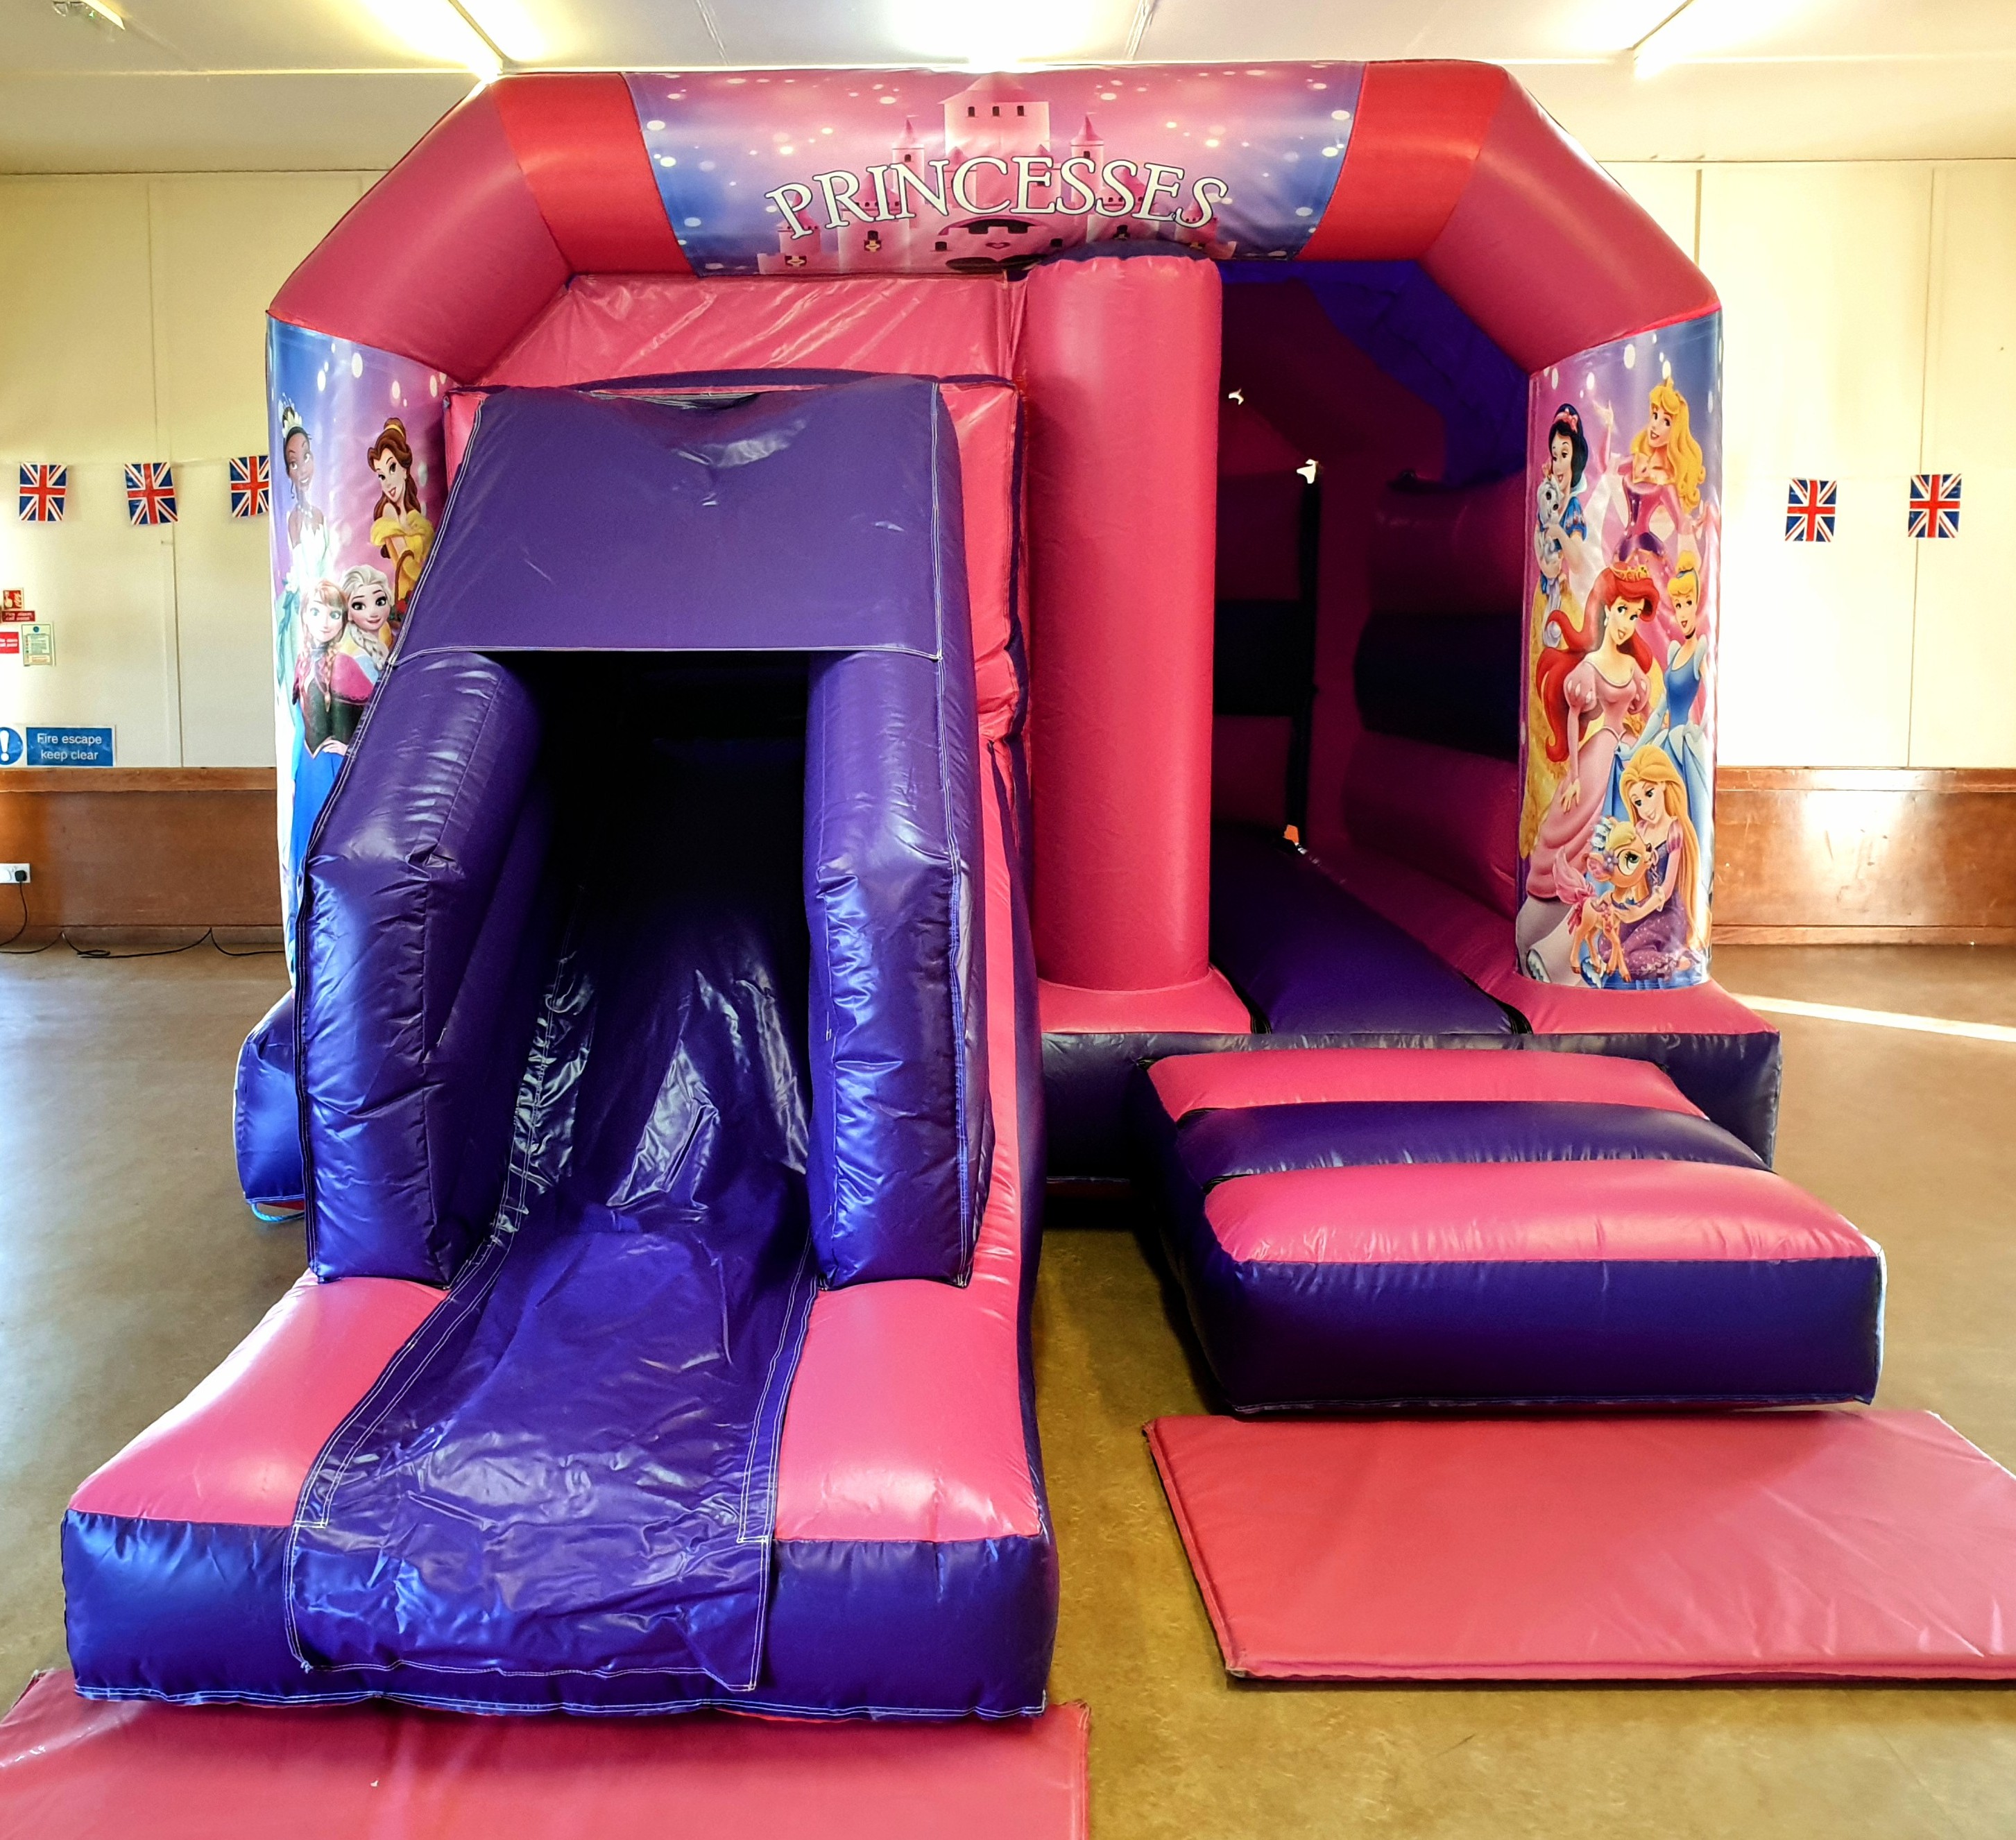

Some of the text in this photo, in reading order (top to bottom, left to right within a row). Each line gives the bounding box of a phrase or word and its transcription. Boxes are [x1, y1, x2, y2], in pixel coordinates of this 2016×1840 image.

[765, 156, 1229, 240] PRINCESSES
[37, 733, 102, 746] Fire escape
[40, 750, 99, 761] keep clear
